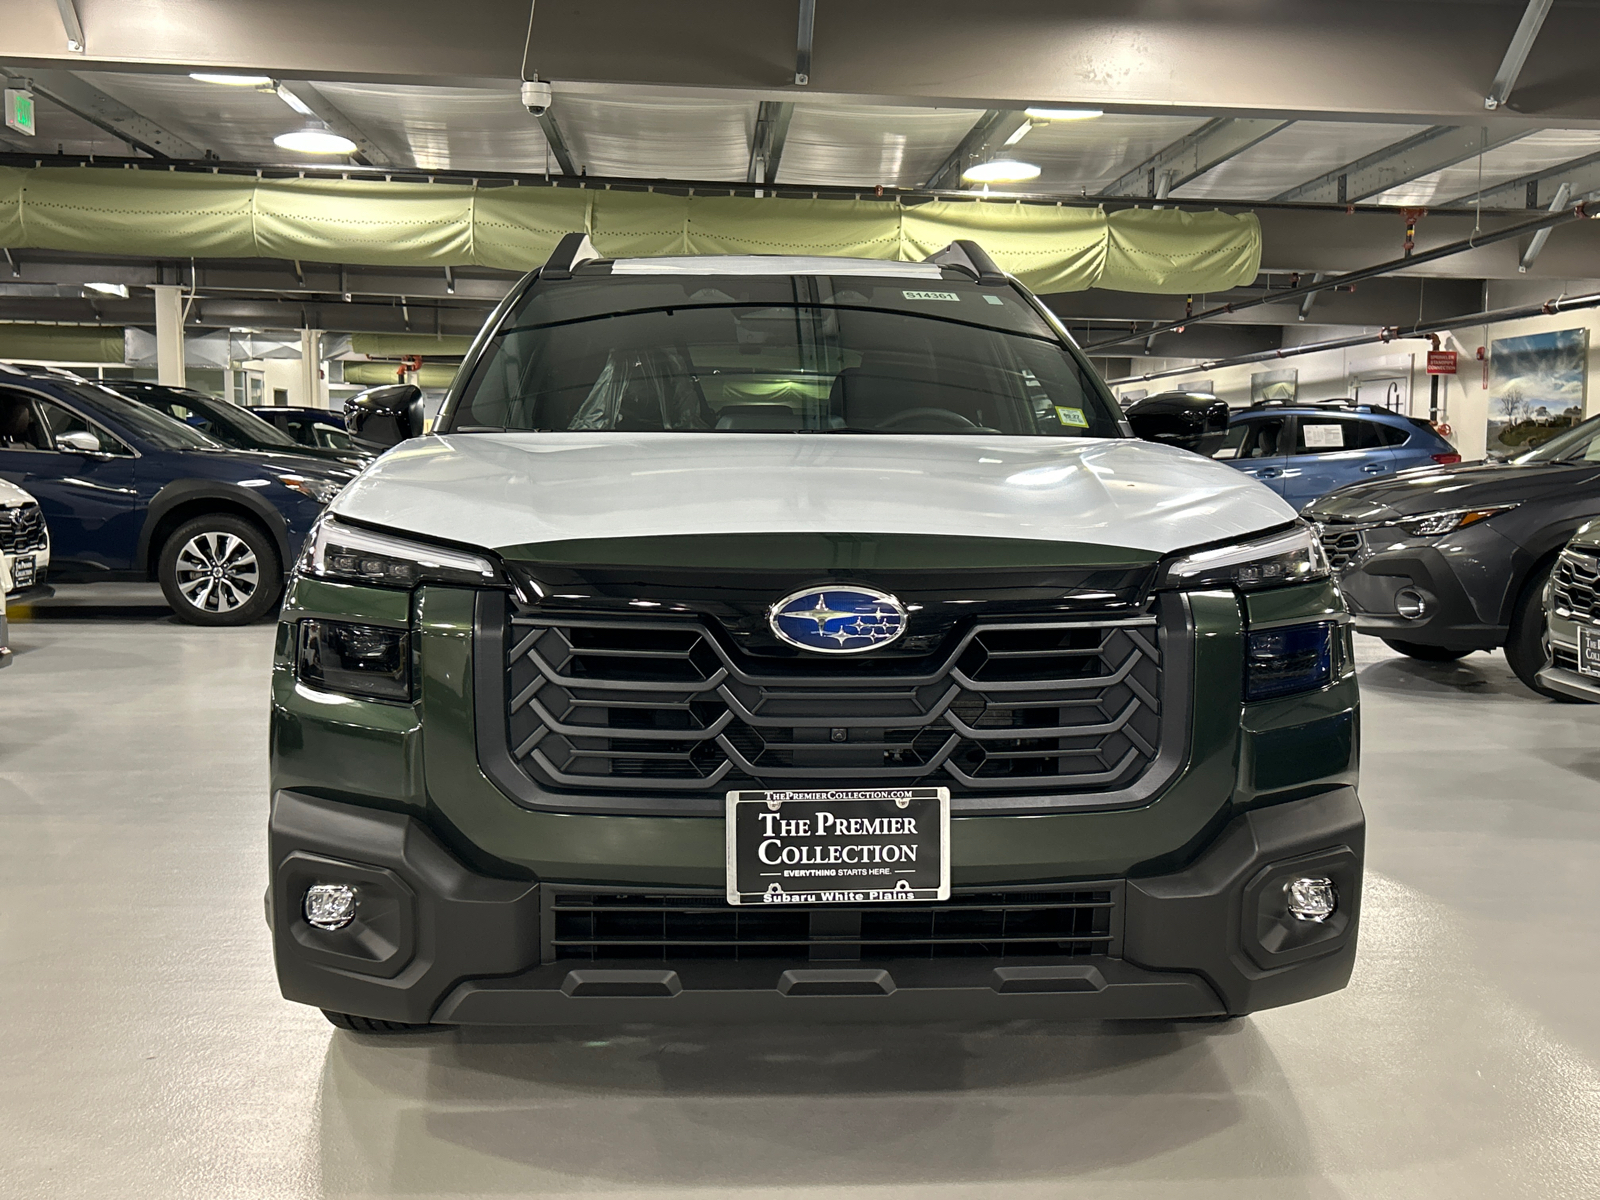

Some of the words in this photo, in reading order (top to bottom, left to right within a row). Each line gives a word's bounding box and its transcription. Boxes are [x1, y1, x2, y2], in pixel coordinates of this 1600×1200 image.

[758, 812, 811, 837] THE
[815, 811, 918, 836] PREMIER
[758, 838, 918, 865] COLLECTION
[783, 869, 836, 877] EVERYTHING
[837, 868, 867, 876] STARTS
[868, 867, 892, 875] HERE.
[763, 893, 816, 903] Subaru
[821, 891, 864, 901] White
[869, 890, 915, 900] Plains
